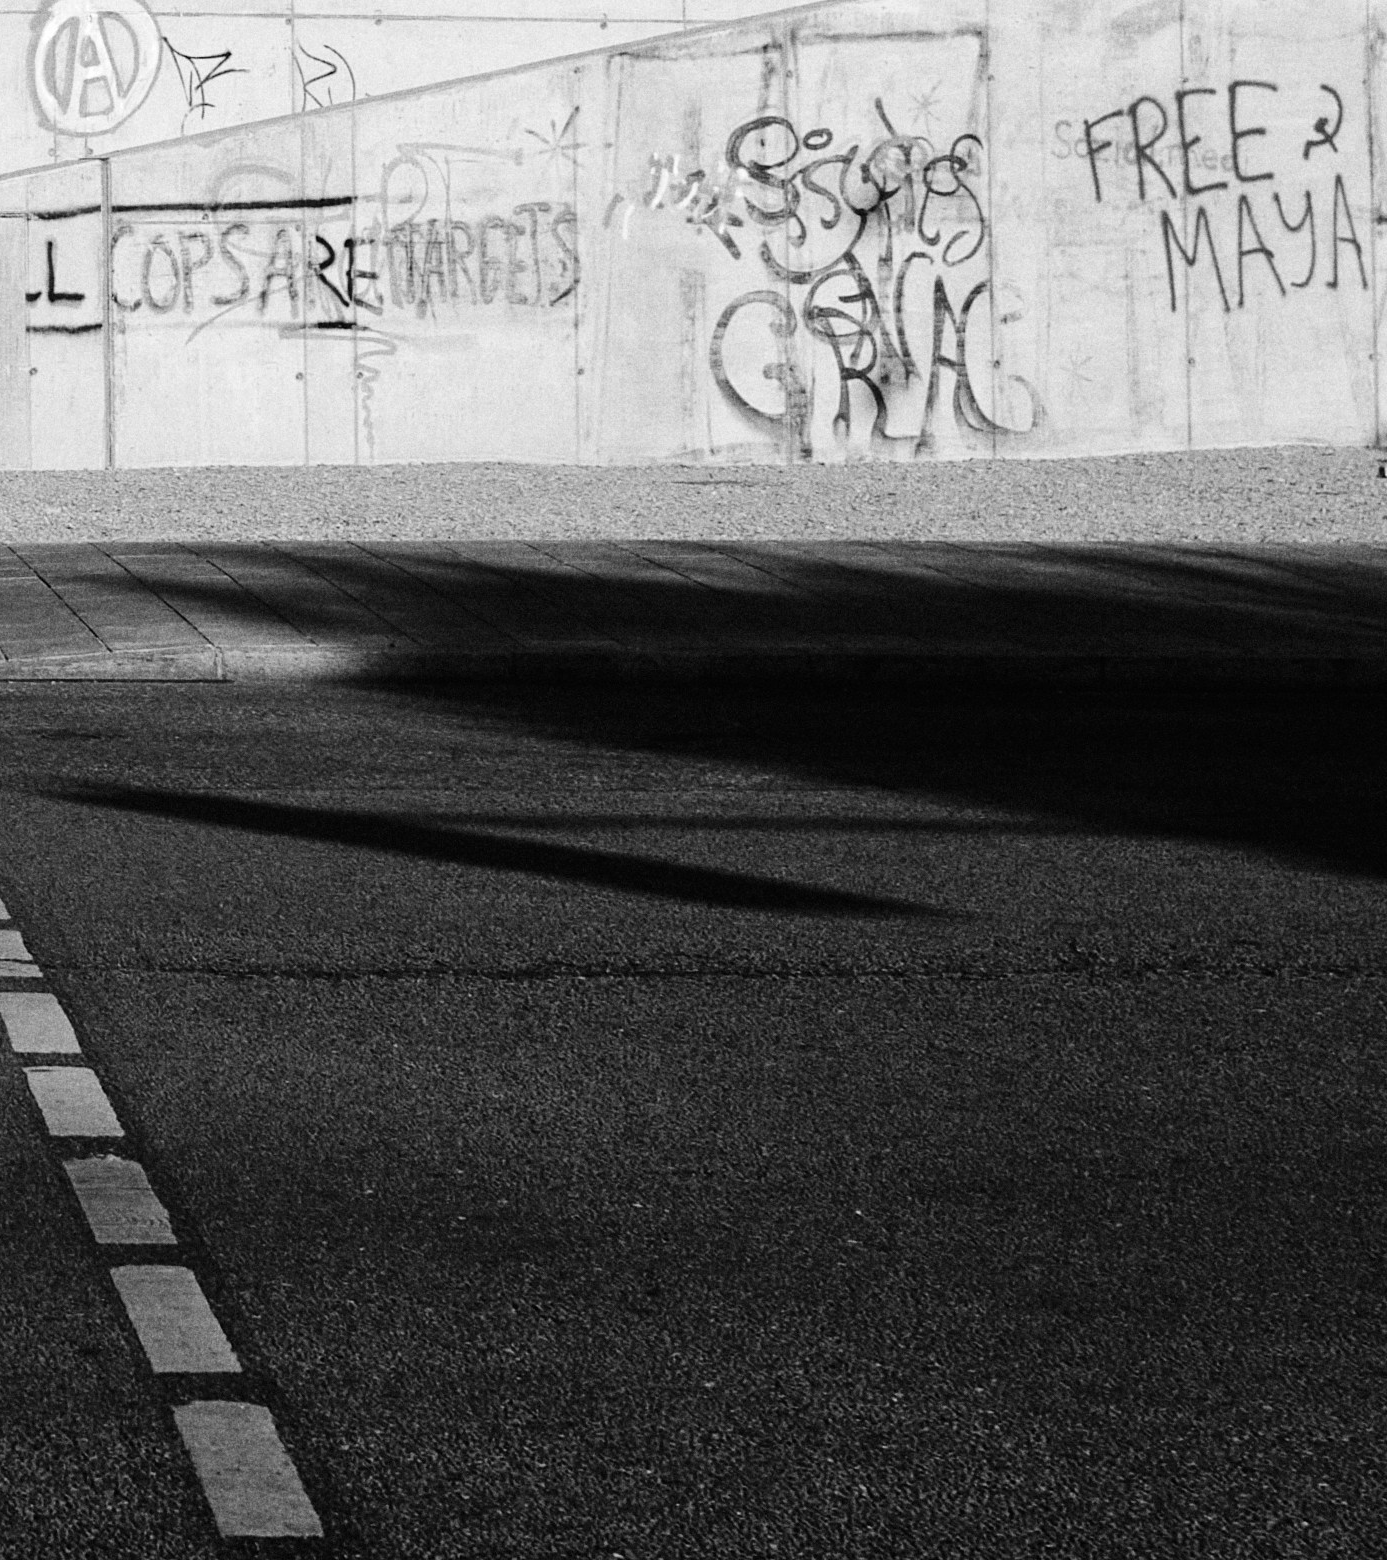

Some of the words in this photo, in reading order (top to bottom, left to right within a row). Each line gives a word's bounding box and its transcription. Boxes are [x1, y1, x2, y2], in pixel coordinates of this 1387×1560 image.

[1082, 80, 1278, 203] FREE
[111, 222, 250, 314] COPS
[1162, 173, 1369, 313] MAYA
